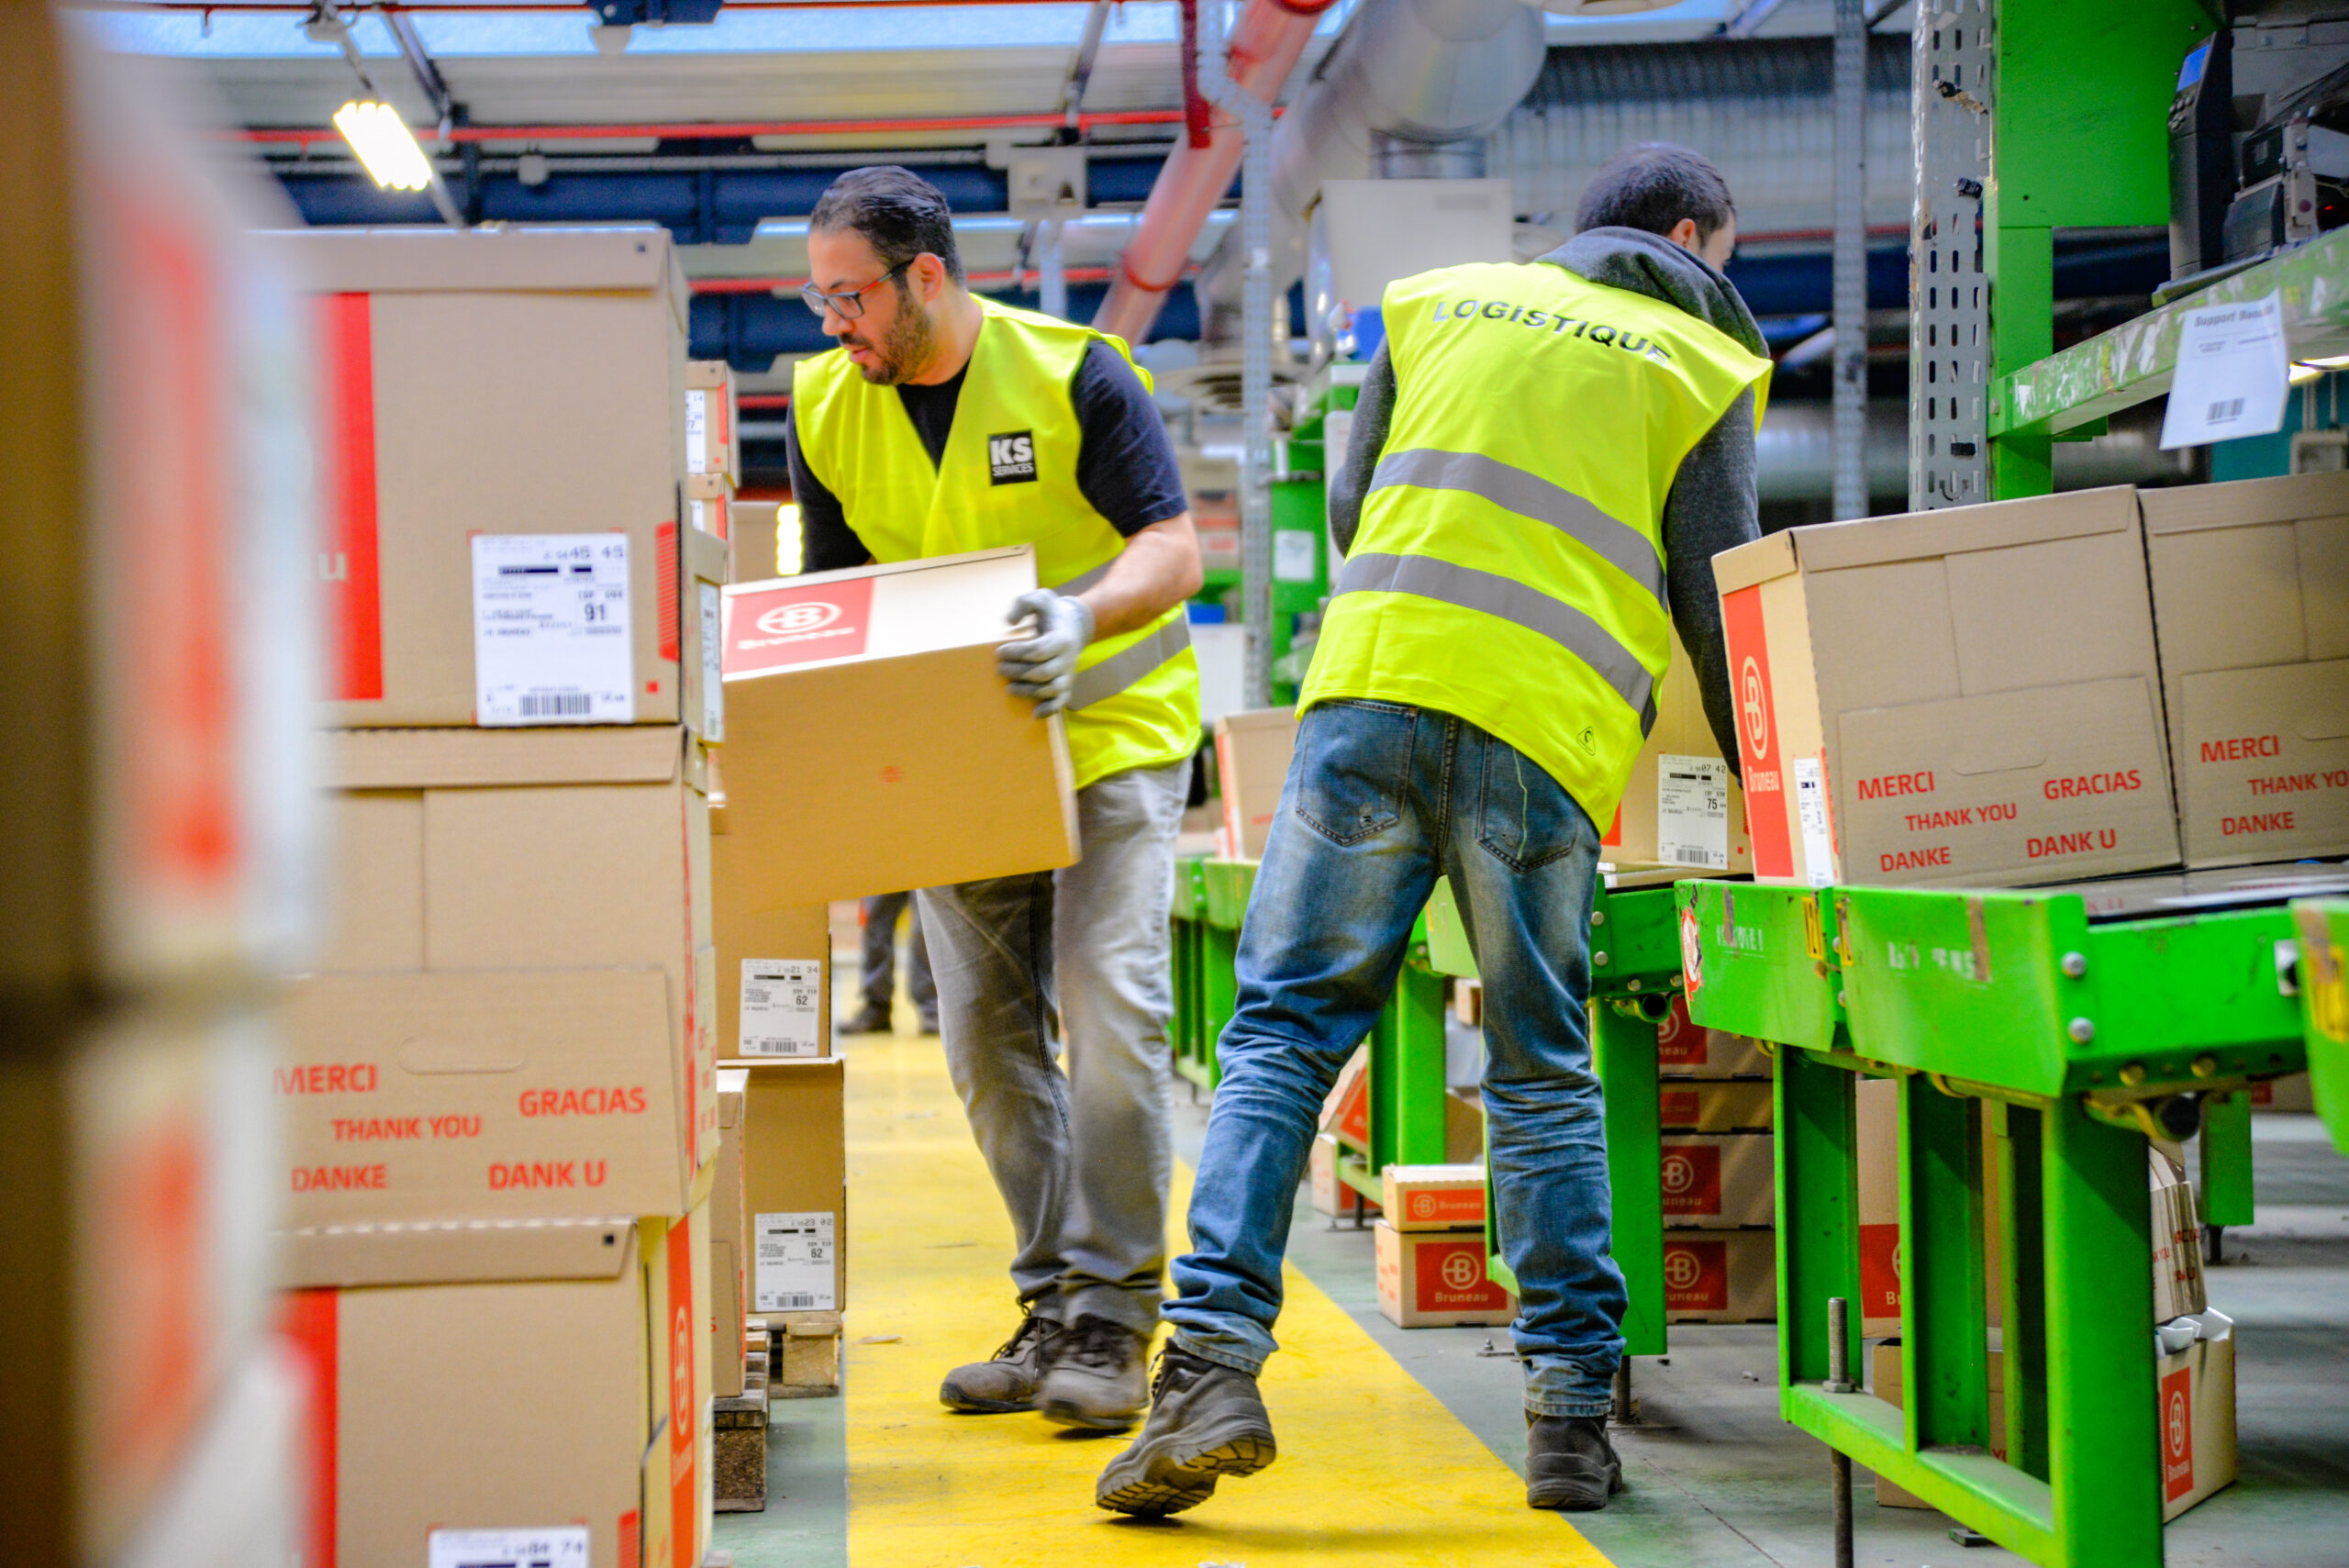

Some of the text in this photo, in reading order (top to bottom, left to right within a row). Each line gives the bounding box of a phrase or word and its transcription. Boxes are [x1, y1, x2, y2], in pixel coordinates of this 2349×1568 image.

[1432, 300, 1670, 367] LOGISTIQUE
[989, 437, 1034, 466] KS
[584, 603, 606, 622] 91
[2200, 735, 2280, 763] MERCI
[1747, 765, 1780, 793] Bruneau
[1858, 772, 1935, 800] MERCI
[2043, 770, 2143, 800] GRACIAS
[2247, 770, 2349, 795] THANK YO
[1707, 798, 1718, 810] 75
[1905, 803, 2018, 832] THANK YOU
[2221, 811, 2296, 837] DANKE
[2027, 828, 2117, 859] DANK U
[1881, 847, 1952, 873] DANKE
[796, 995, 808, 1006] 62
[1658, 1047, 1688, 1056] neau
[273, 1064, 377, 1095] MERCI
[518, 1087, 647, 1118] GRACIAS
[331, 1115, 483, 1142] THANK YOU
[291, 1162, 387, 1193] DANKE
[488, 1160, 607, 1191] DANK U
[1439, 1201, 1482, 1210] Bruneau
[1663, 1196, 1702, 1207] uneau
[811, 1249, 823, 1259] 62
[1435, 1292, 1489, 1303] Bruneau
